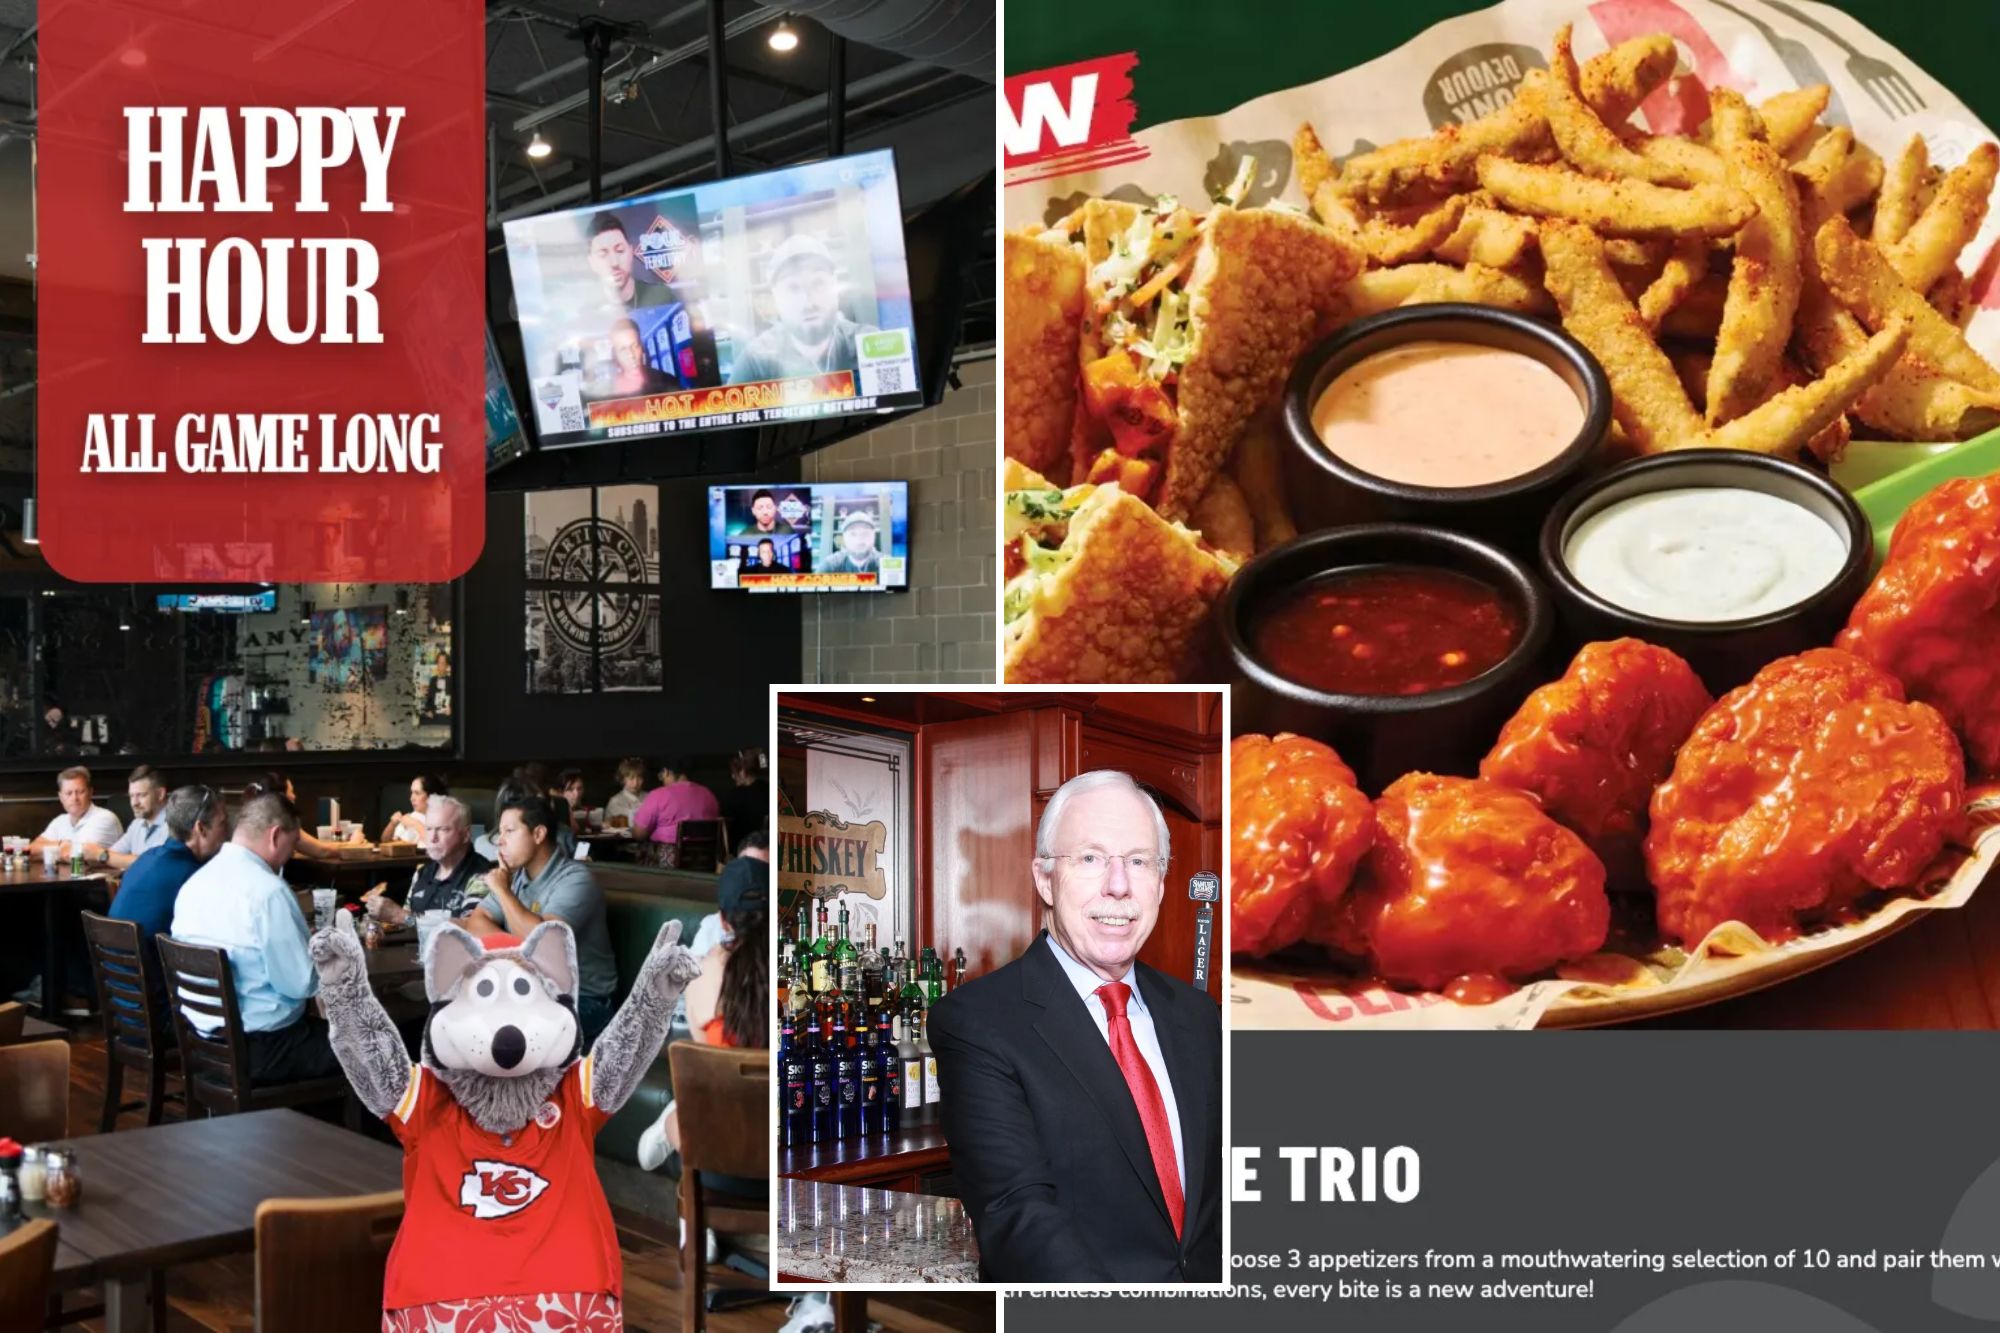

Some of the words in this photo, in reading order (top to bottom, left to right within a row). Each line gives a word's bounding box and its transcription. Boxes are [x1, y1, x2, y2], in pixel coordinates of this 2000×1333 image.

[1437, 55, 1521, 104] DEVOUR
[608, 421, 661, 438] SUBSCRIBE
[663, 419, 676, 431] TO
[678, 416, 697, 429] THE
[700, 412, 734, 427] ENTIRE
[736, 410, 760, 423] FOUL
[823, 397, 877, 413] NETWORK
[645, 394, 694, 419] HOT
[706, 379, 813, 410] CORNER
[551, 527, 612, 581] MARTIN
[617, 541, 641, 583] CITY
[556, 609, 590, 642] BREWING
[603, 613, 637, 643] COMPANY
[1195, 924, 1207, 980] LAGER
[479, 1170, 532, 1206] KC
